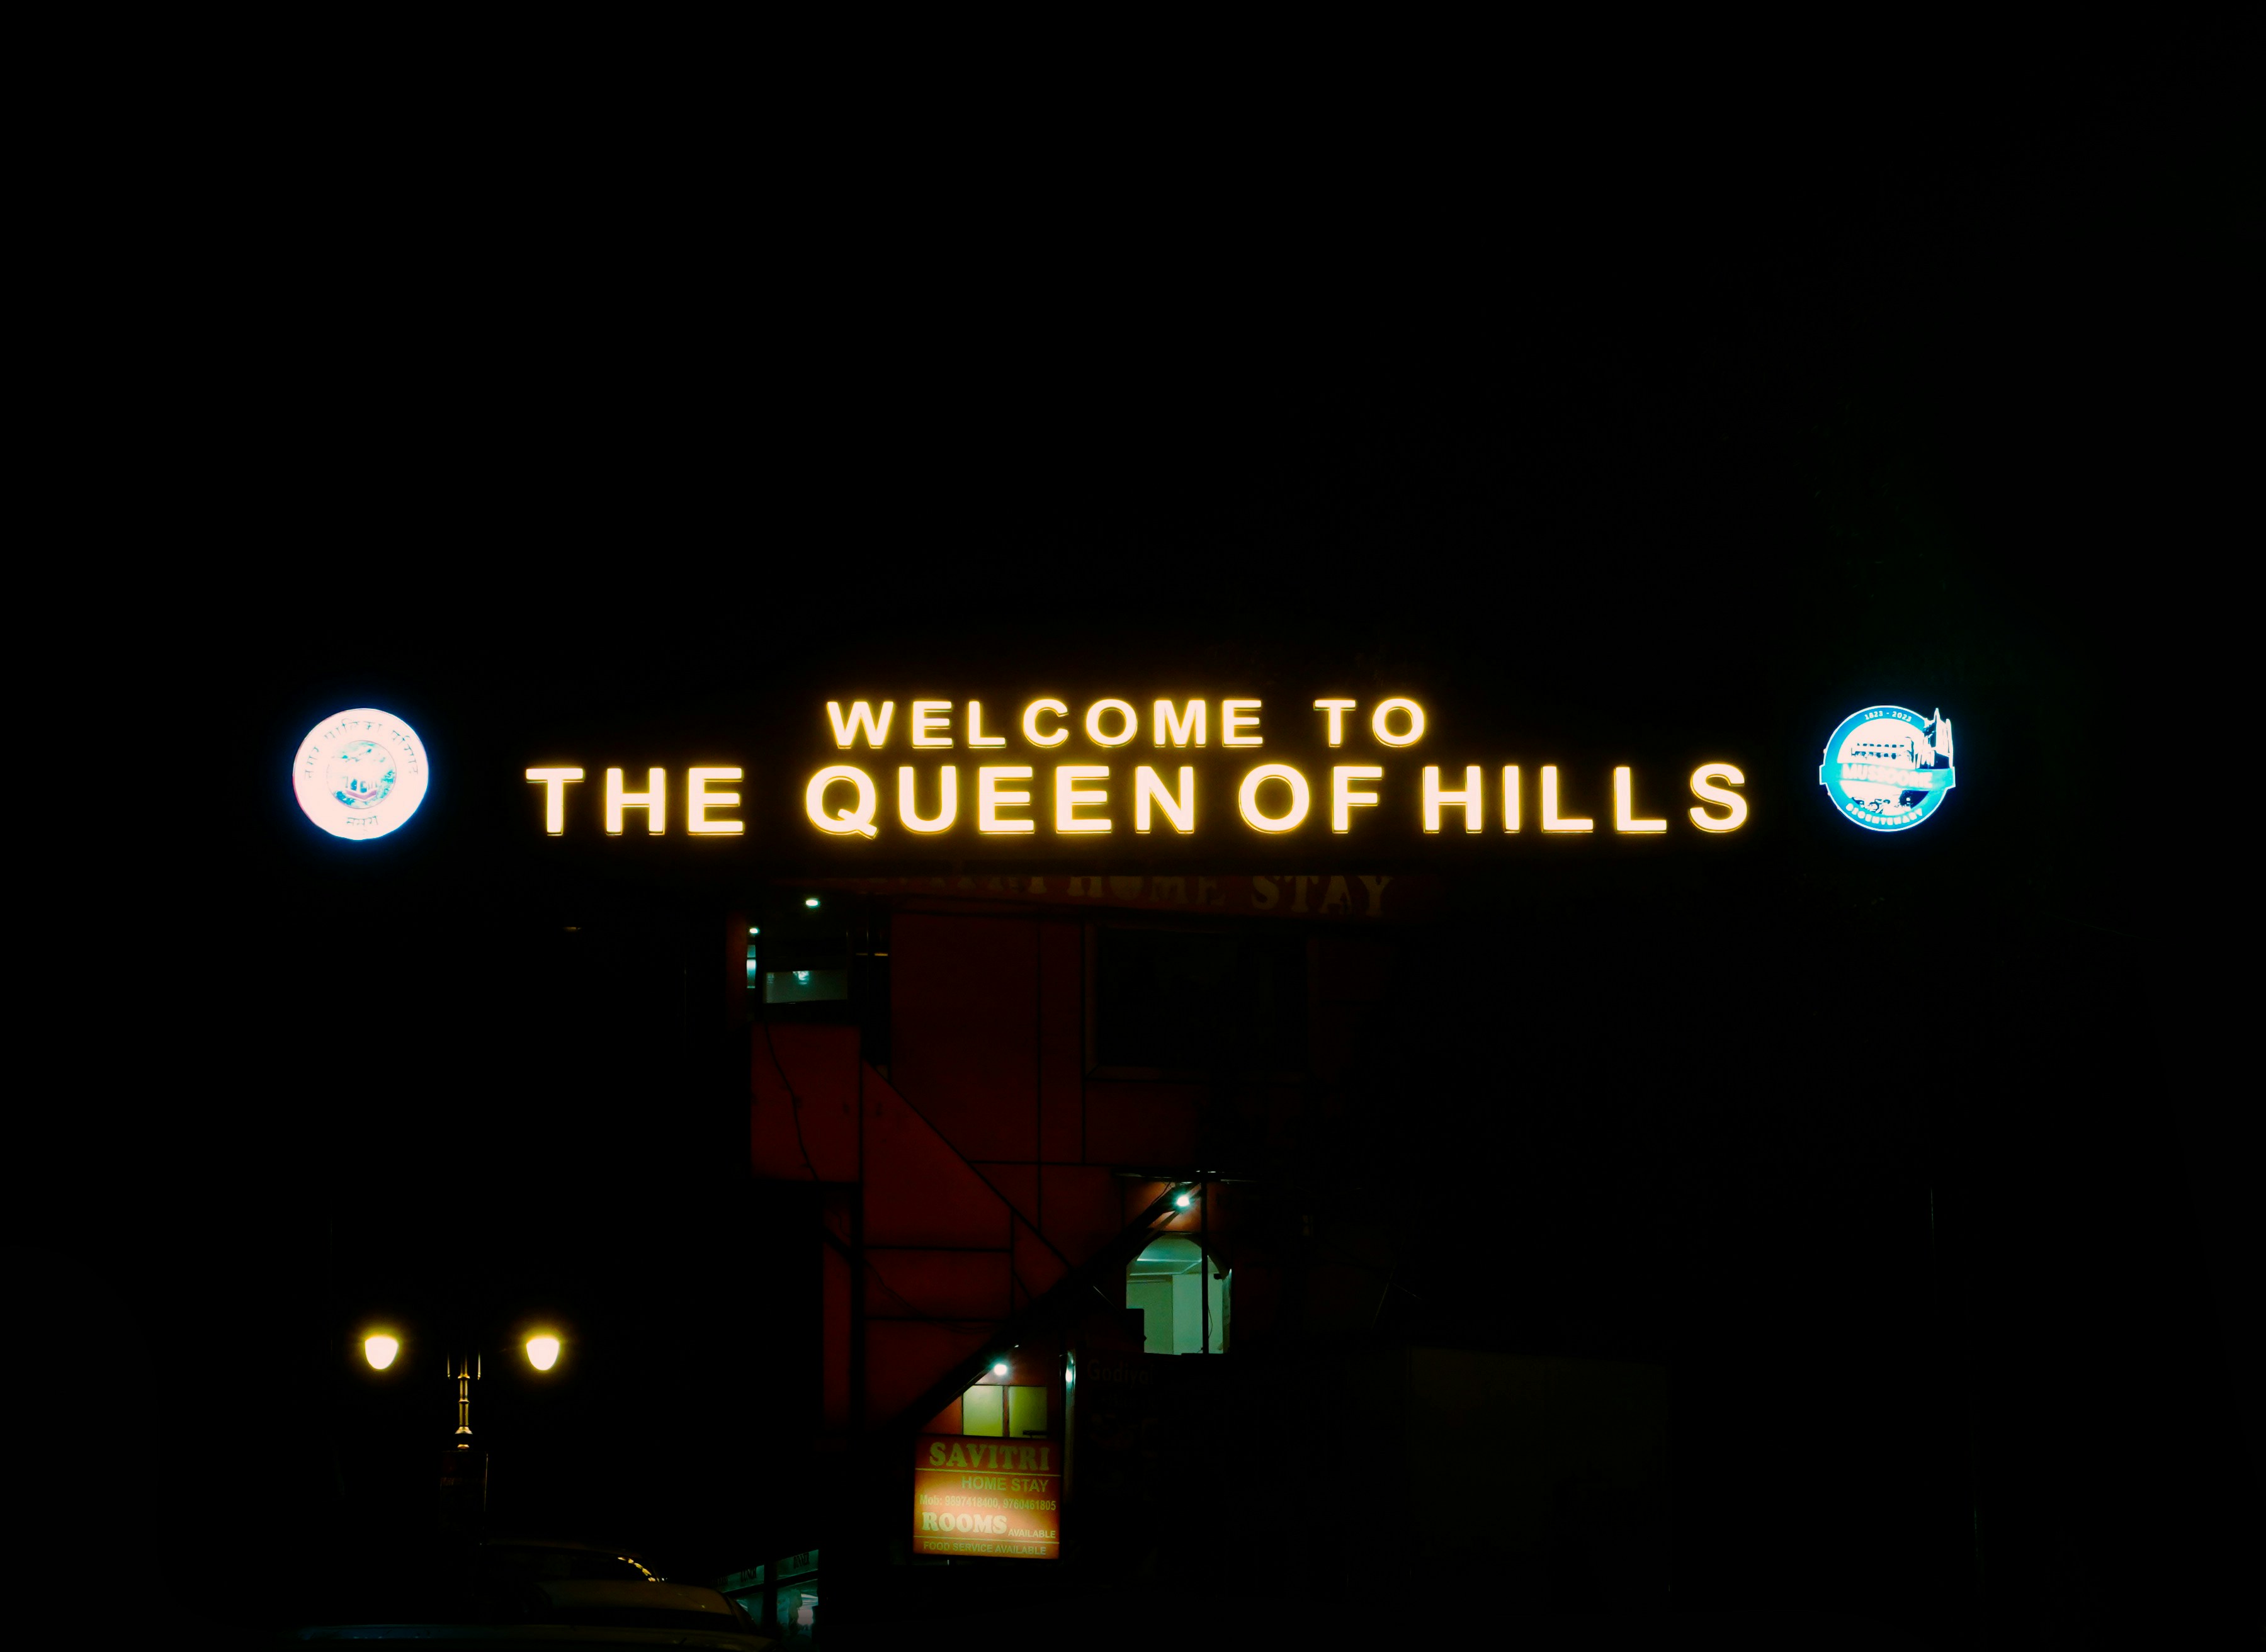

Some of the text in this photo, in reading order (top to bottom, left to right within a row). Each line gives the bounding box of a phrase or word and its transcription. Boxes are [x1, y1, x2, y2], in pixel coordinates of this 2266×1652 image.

[827, 697, 1425, 749] WELCOME TO
[1892, 711, 1912, 722] 2023
[526, 762, 1747, 839] THE QUEEN OF HILLS
[1250, 876, 1395, 917] STAY
[929, 1442, 1050, 1471] SAVITRI
[961, 1476, 1048, 1492] HOME STAY
[922, 1512, 1056, 1539] ROOMS AVAILABLE
[924, 1542, 1046, 1555] FOOD SERVICE AVAILABLE
